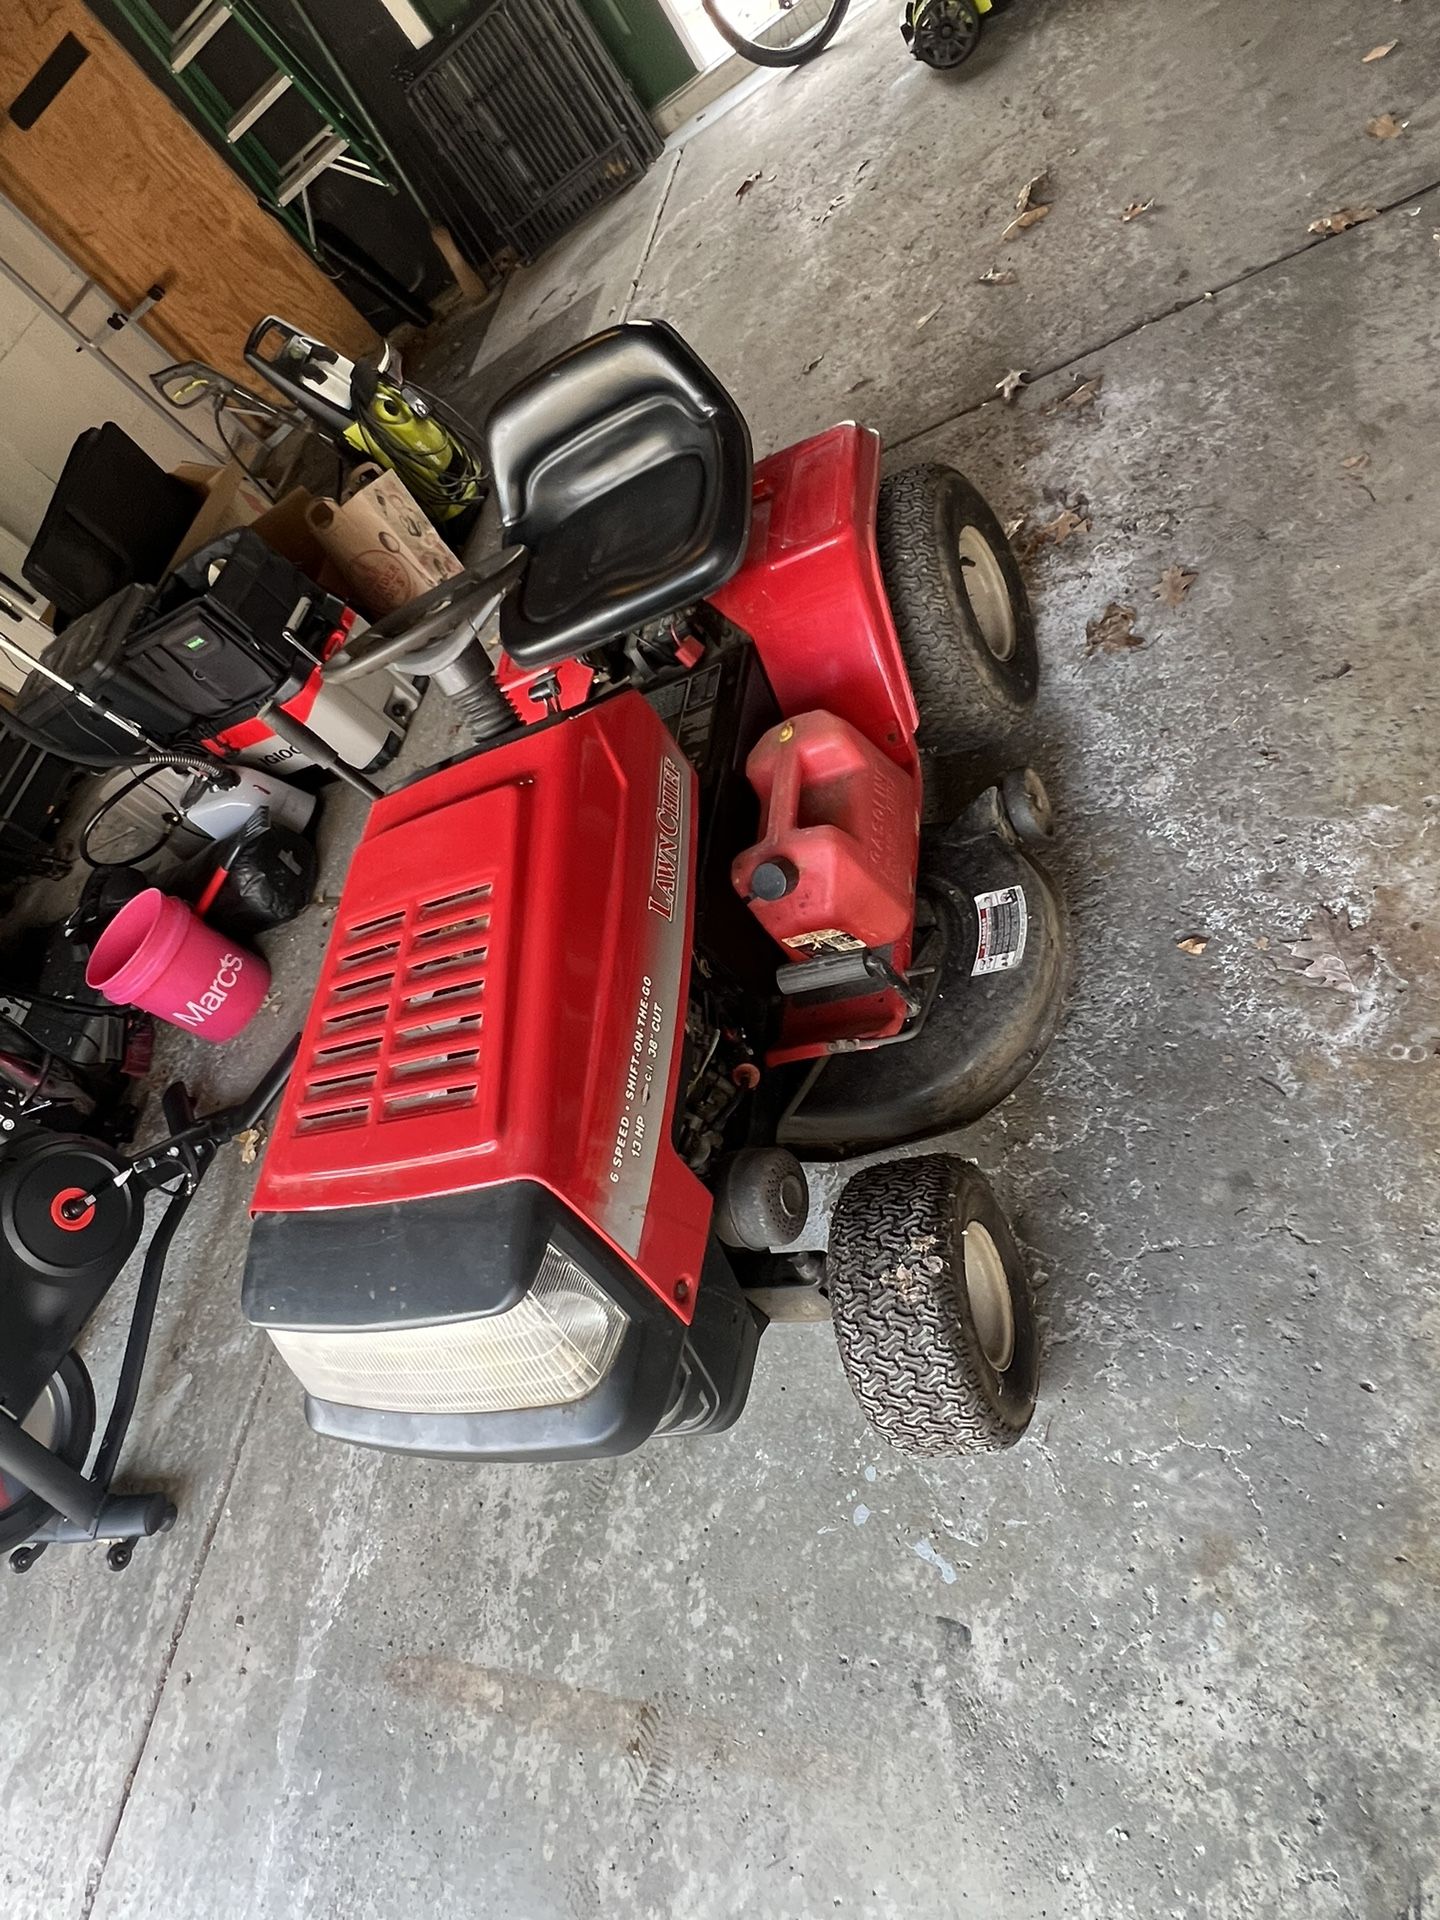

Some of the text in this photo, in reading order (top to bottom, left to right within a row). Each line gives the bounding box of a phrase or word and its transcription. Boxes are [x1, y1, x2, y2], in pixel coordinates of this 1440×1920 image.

[172, 953, 243, 1027] Marc's
[651, 1002, 662, 1033] CUT
[634, 1115, 645, 1139] HP
[612, 1116, 630, 1168] SPEED
[631, 1140, 642, 1157] 13
[609, 1171, 620, 1183] 6
